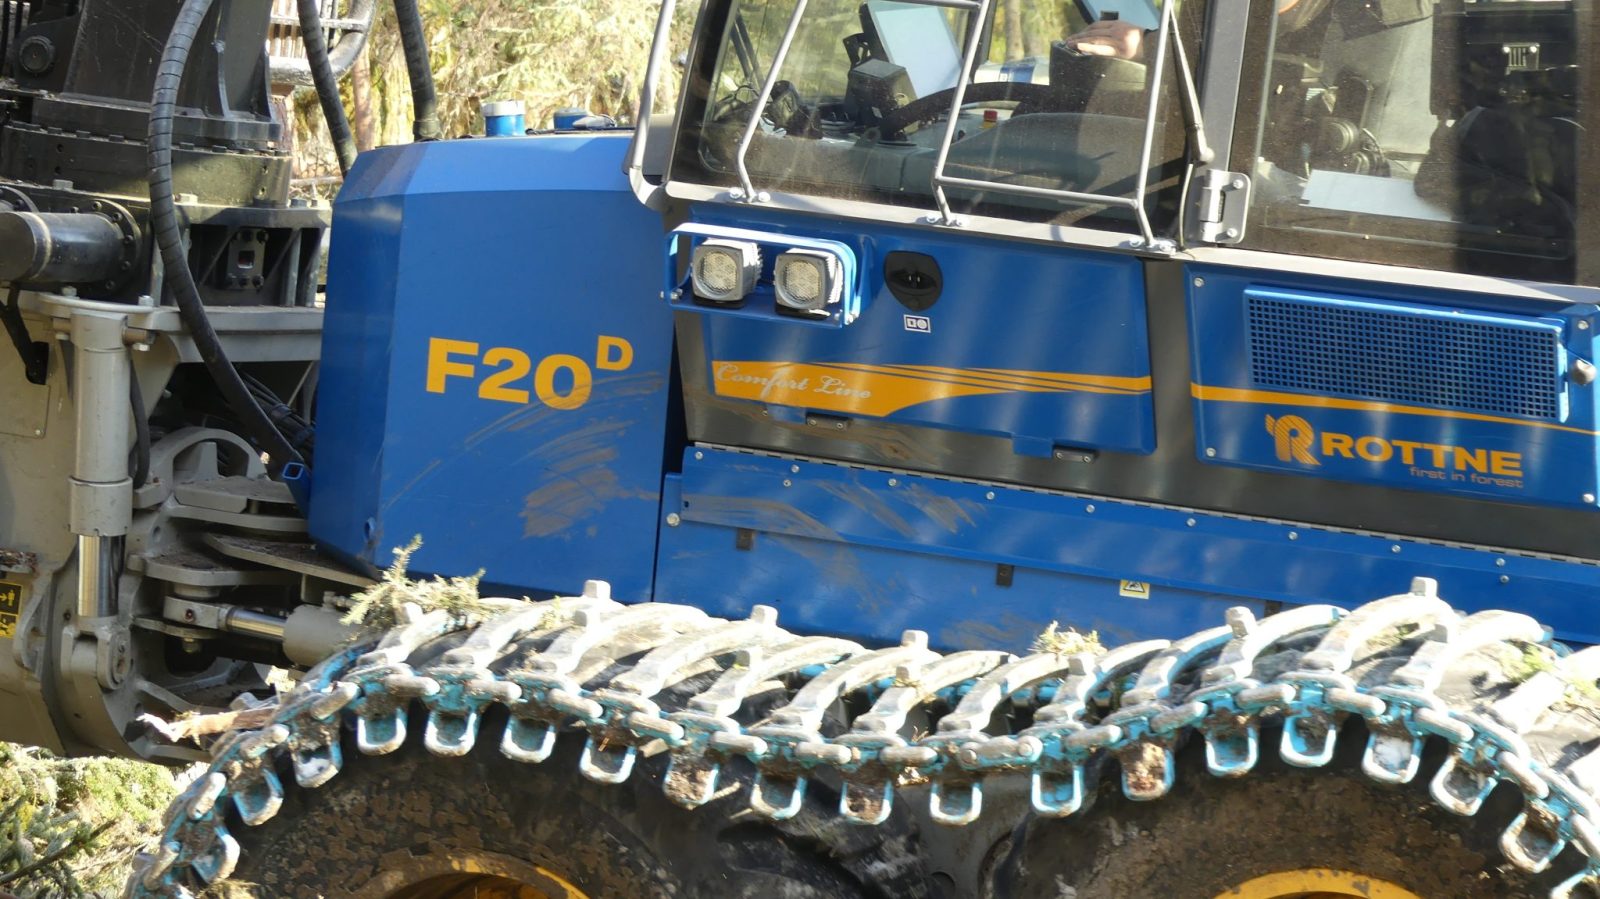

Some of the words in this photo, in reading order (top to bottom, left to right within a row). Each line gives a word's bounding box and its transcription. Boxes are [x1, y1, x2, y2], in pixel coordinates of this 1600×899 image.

[715, 362, 810, 400] Comfort
[814, 375, 872, 400] Line
[1320, 431, 1523, 477] ROTTNE
[1410, 466, 1446, 481] first
[1452, 471, 1465, 483] in
[1471, 474, 1523, 488] forest
